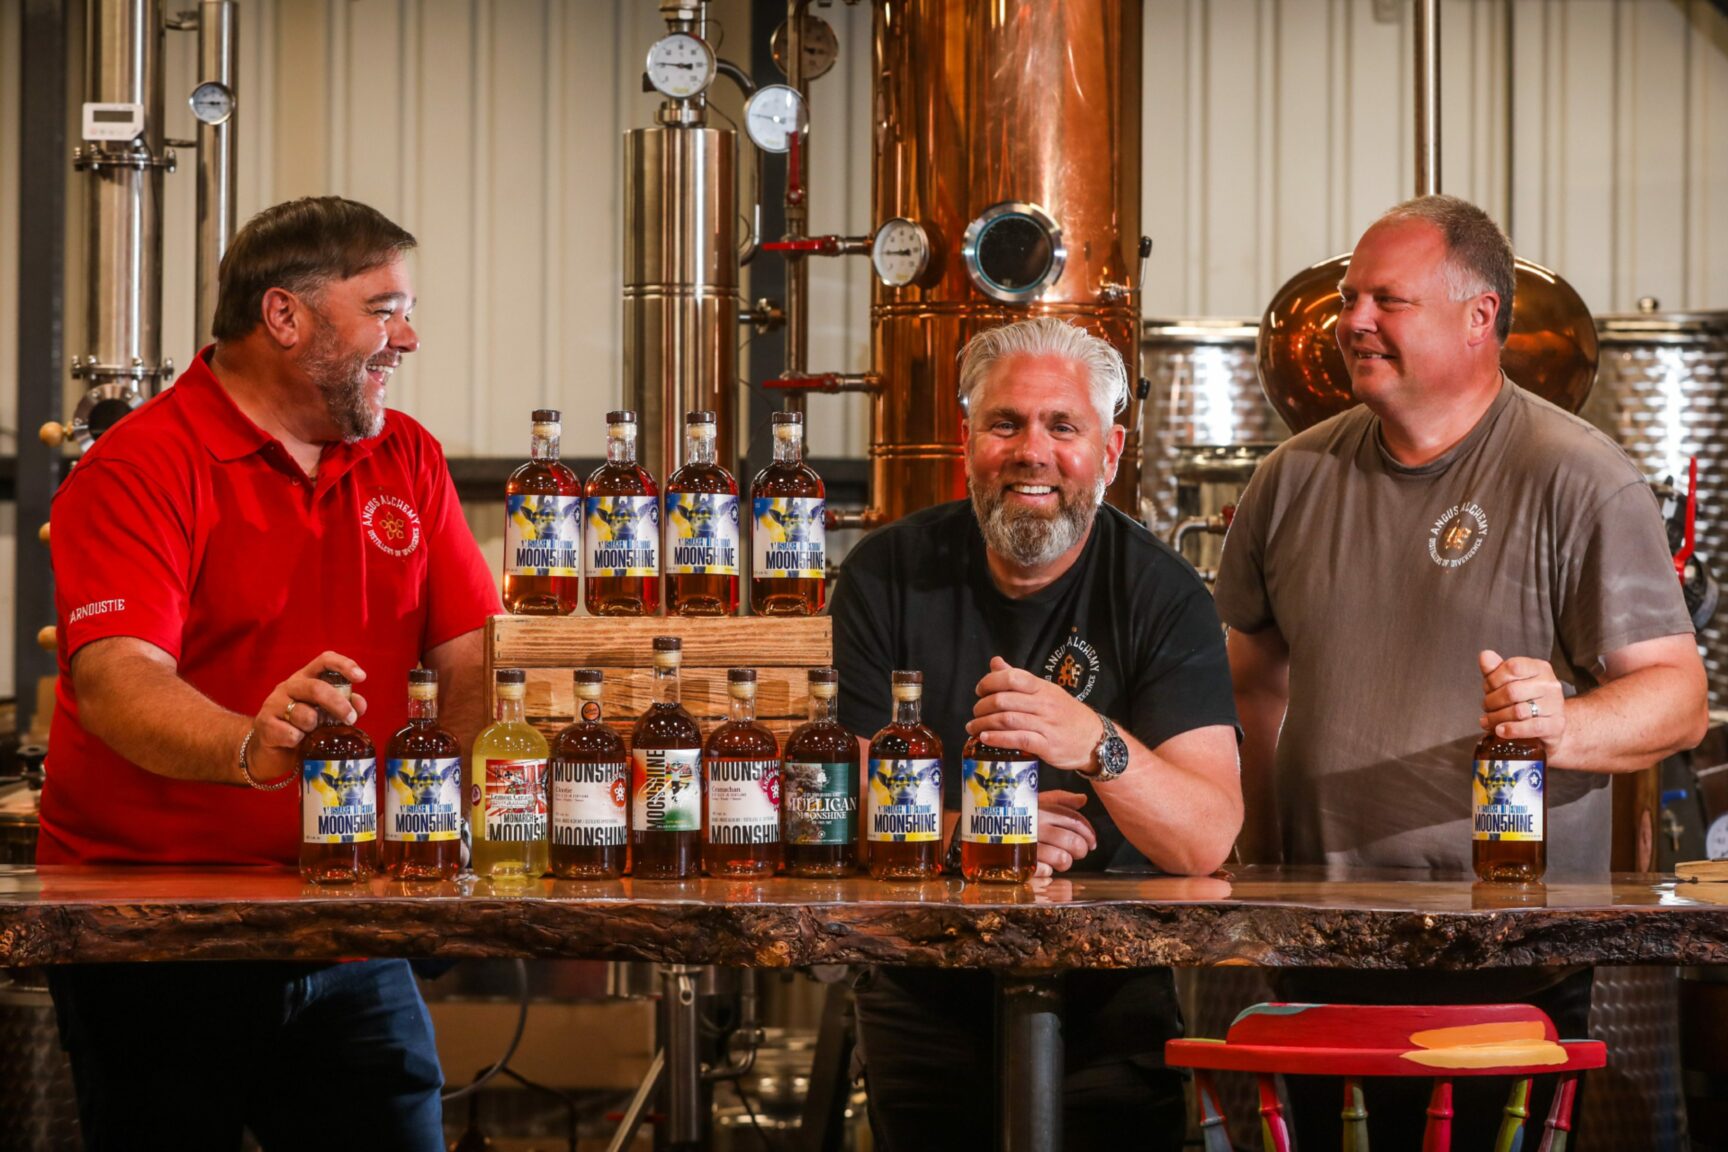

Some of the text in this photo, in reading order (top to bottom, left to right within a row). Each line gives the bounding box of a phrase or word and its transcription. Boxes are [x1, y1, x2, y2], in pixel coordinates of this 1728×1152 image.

[362, 494, 420, 527] ANGUS ALCHEMY
[1430, 501, 1488, 535] ANGUS ALCHEMY
[1044, 635, 1100, 673] ANGU ALCHEMY
[503, 813, 533, 823] MONARCH
